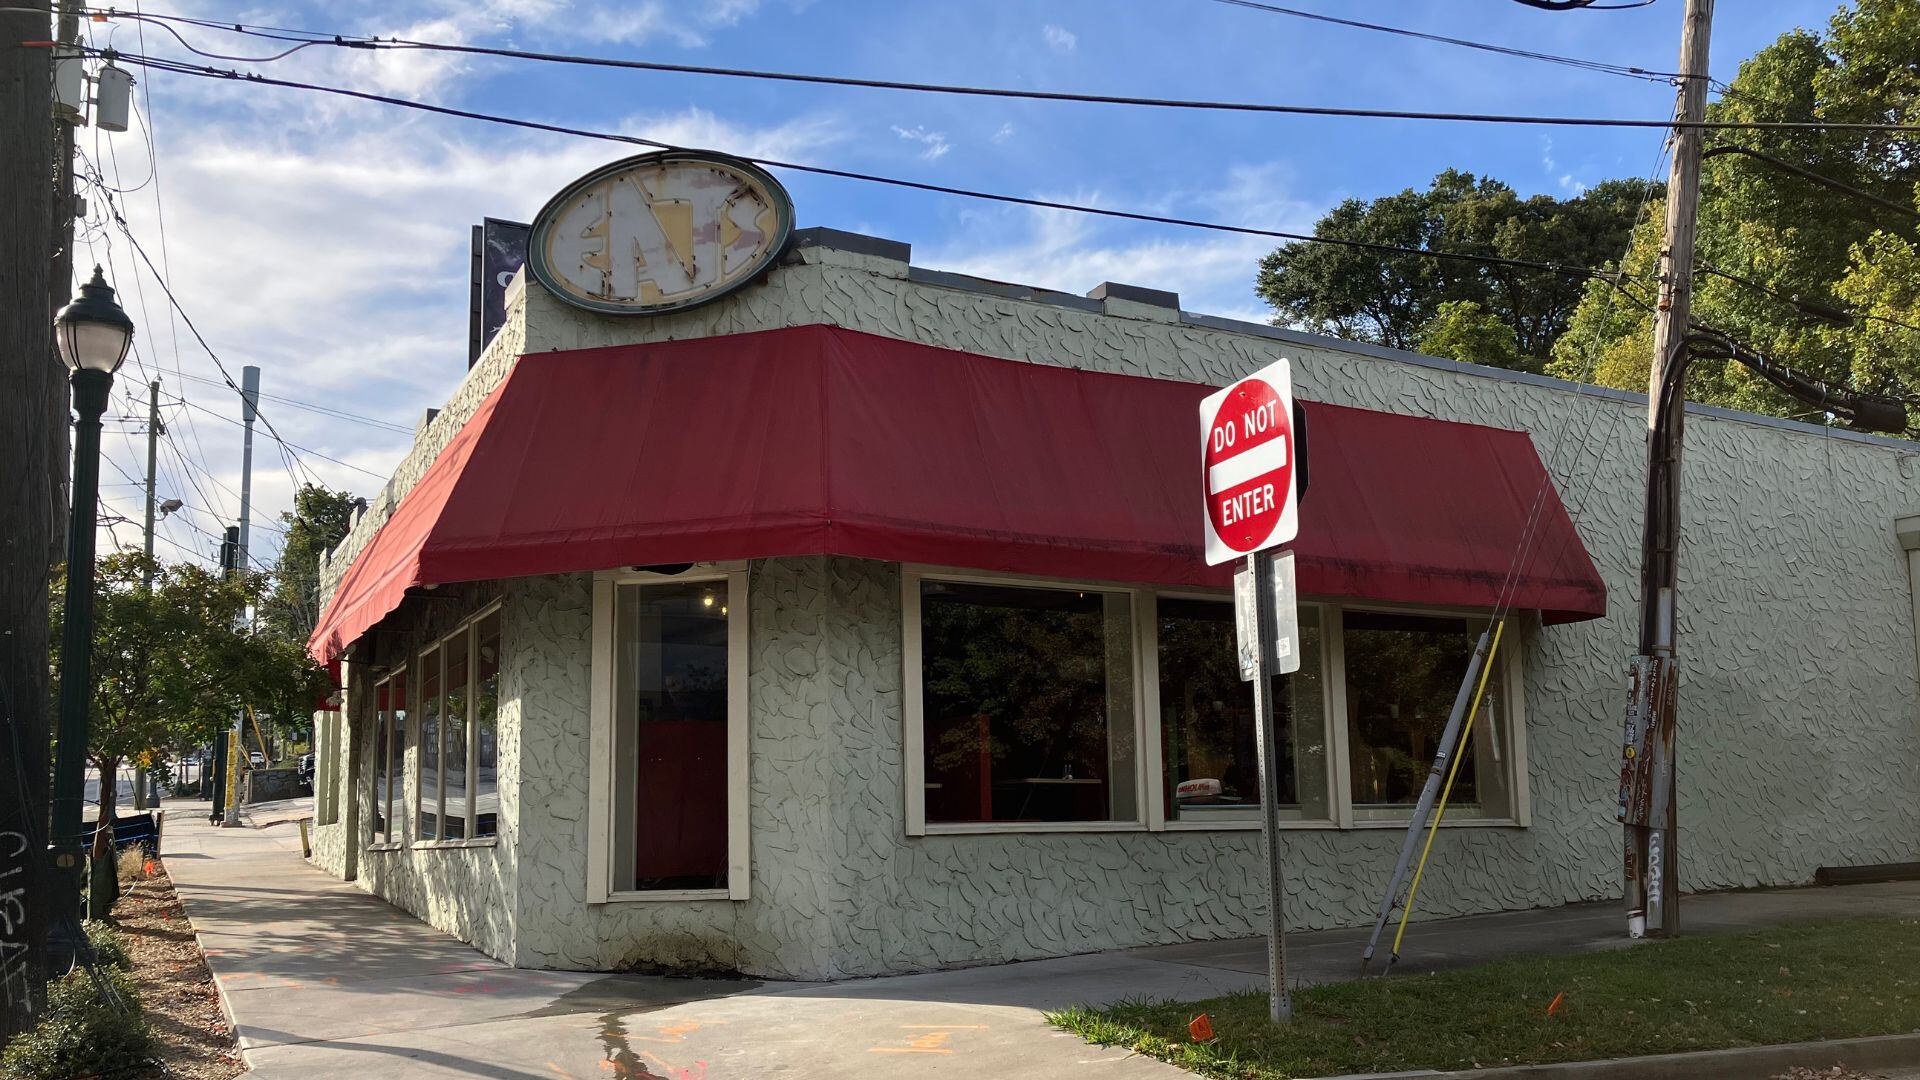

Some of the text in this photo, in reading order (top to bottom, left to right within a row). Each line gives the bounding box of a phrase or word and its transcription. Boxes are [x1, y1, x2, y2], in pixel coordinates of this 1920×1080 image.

[551, 165, 766, 299] EATS
[1214, 400, 1277, 453] DO NOT
[1222, 483, 1275, 527] ENTER
